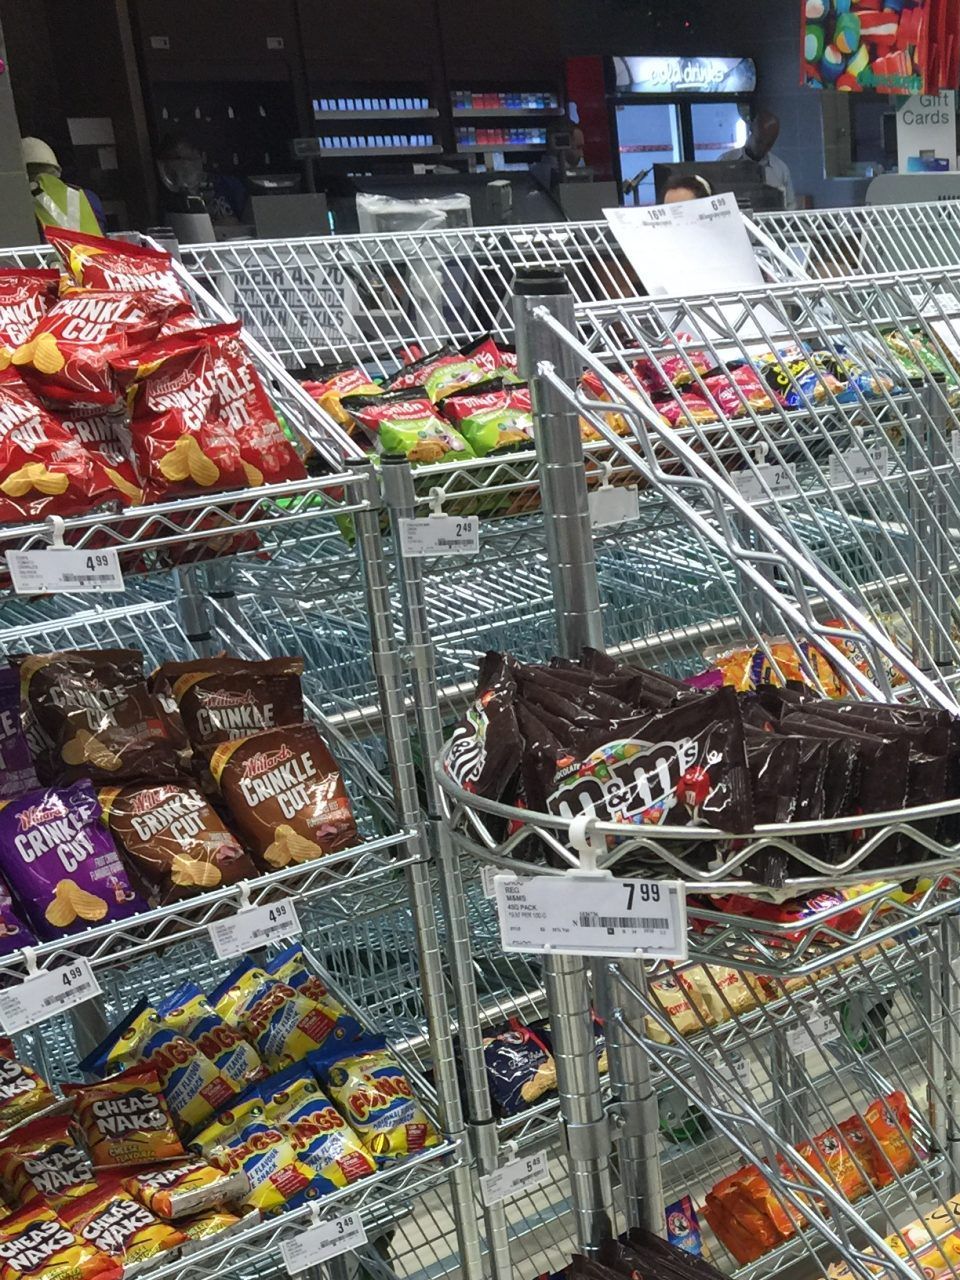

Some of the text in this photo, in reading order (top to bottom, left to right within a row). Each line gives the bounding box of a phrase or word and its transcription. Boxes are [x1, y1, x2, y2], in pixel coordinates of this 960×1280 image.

[919, 91, 949, 108] Gift
[902, 110, 950, 126] Cards
[61, 318, 113, 343] CUT
[260, 310, 287, 328] VAN
[313, 310, 344, 328] KIES
[196, 703, 274, 737] CRINKLE
[243, 744, 294, 778] Willards
[239, 752, 318, 808] CRINKLE
[131, 788, 206, 842] CRINKLE
[277, 785, 312, 821] CUT
[13, 804, 94, 865] CRINKLE
[169, 813, 207, 848] CUT
[55, 832, 97, 874] CUT
[92, 1093, 159, 1118] CHEAS
[32, 1159, 94, 1194] NAKS
[81, 1198, 141, 1241] CHEAS
[96, 1208, 156, 1252] NAKS
[0, 1219, 62, 1260] CHEAS
[8, 1228, 77, 1273] NAKS
